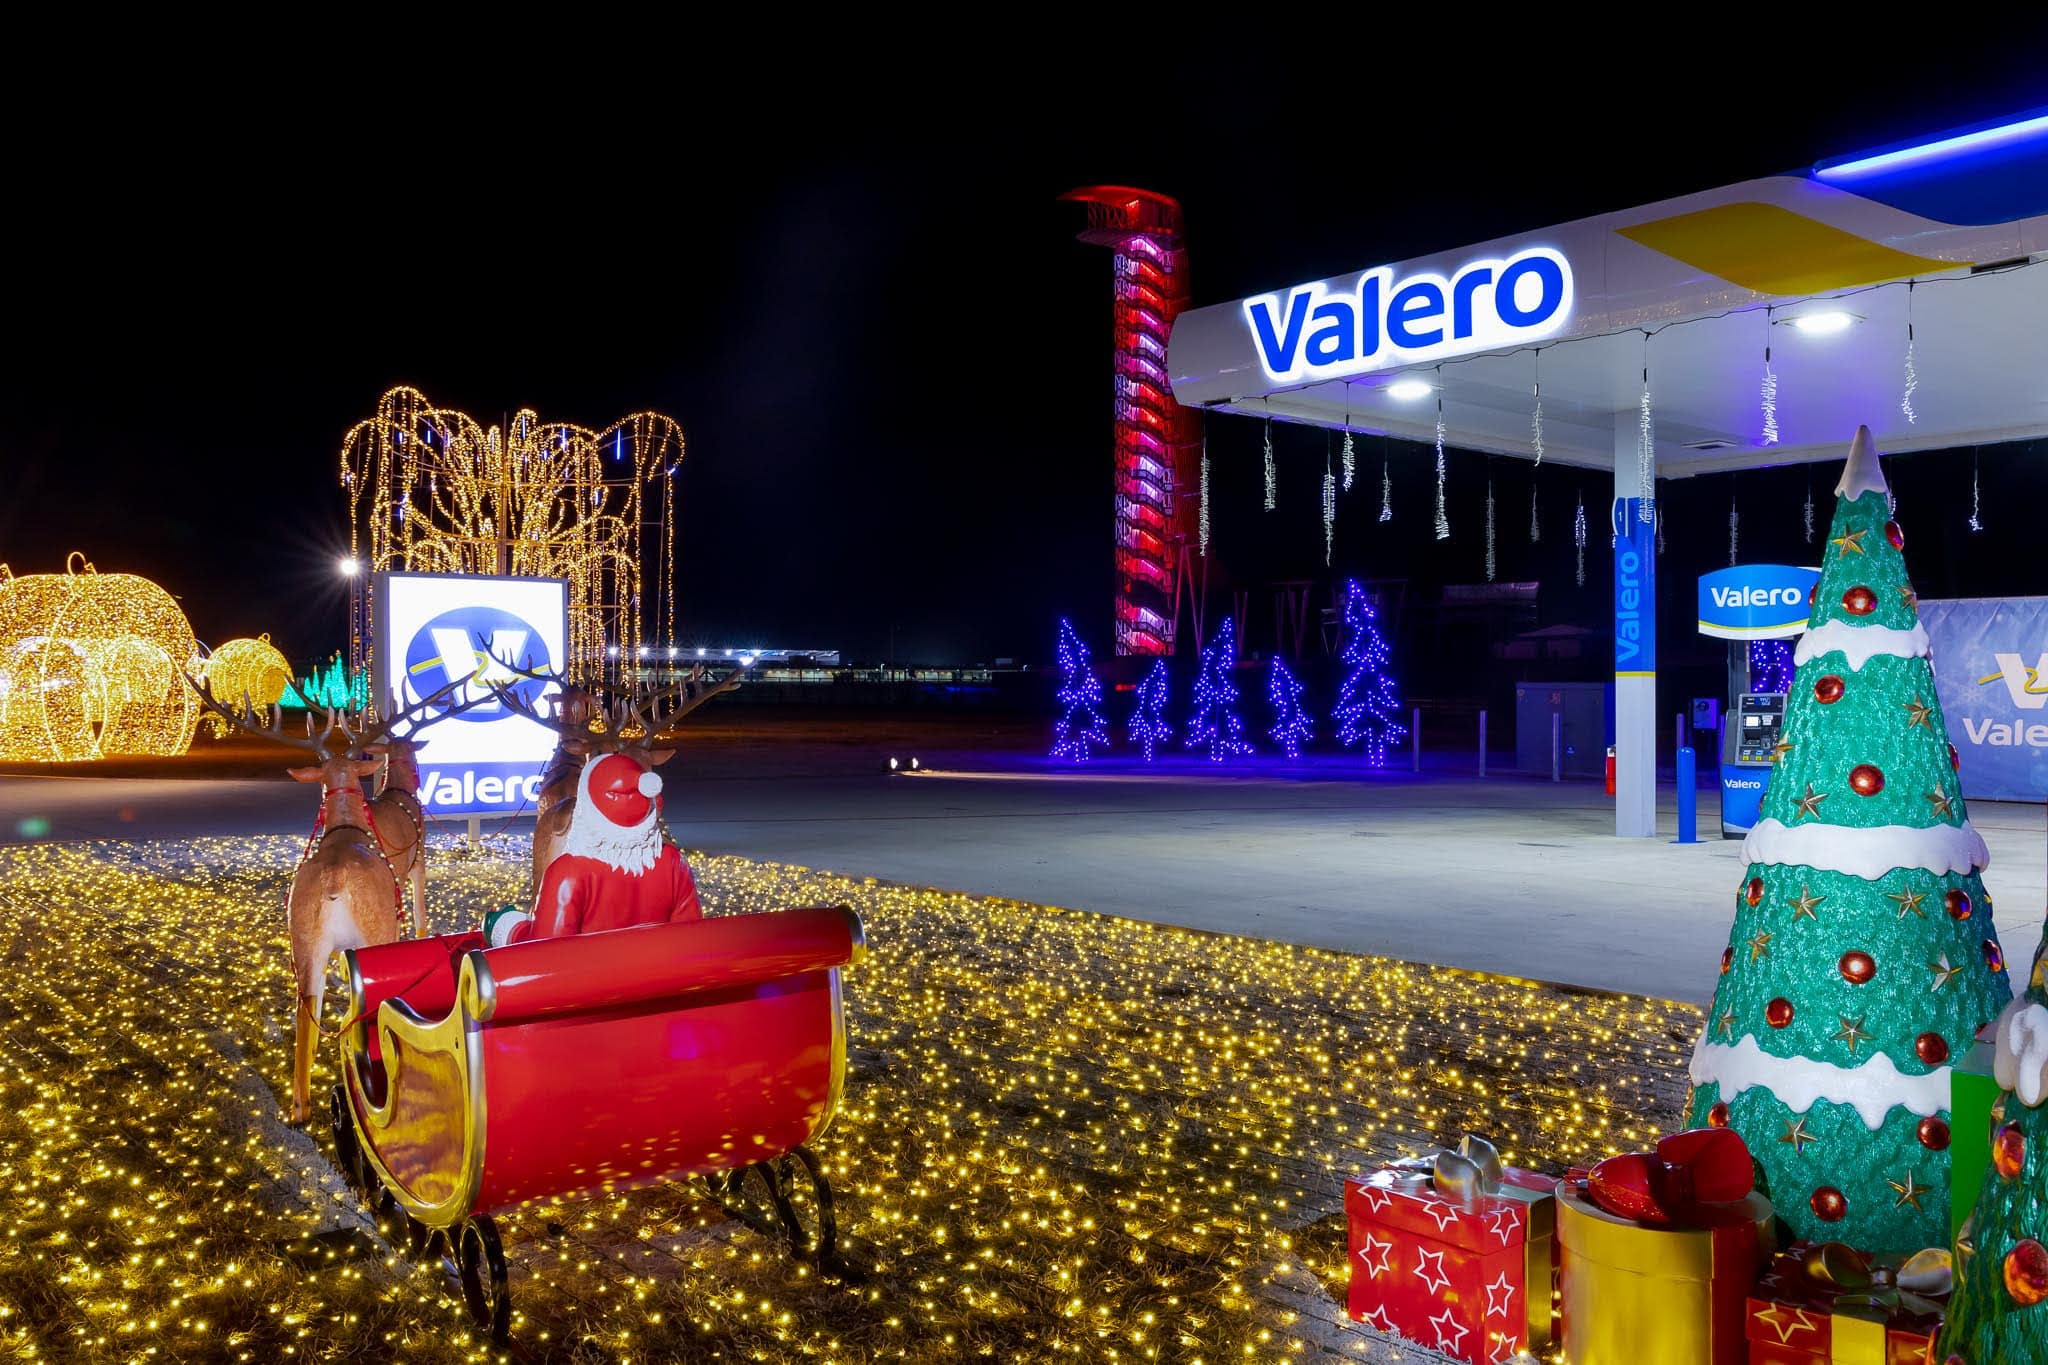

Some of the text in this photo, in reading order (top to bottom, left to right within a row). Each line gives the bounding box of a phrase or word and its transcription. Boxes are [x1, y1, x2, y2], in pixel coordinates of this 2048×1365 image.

[1250, 256, 1563, 373] Valero
[1616, 551, 1640, 663] Valero
[1710, 585, 1802, 608] Valero
[1724, 779, 1761, 789] Valero
